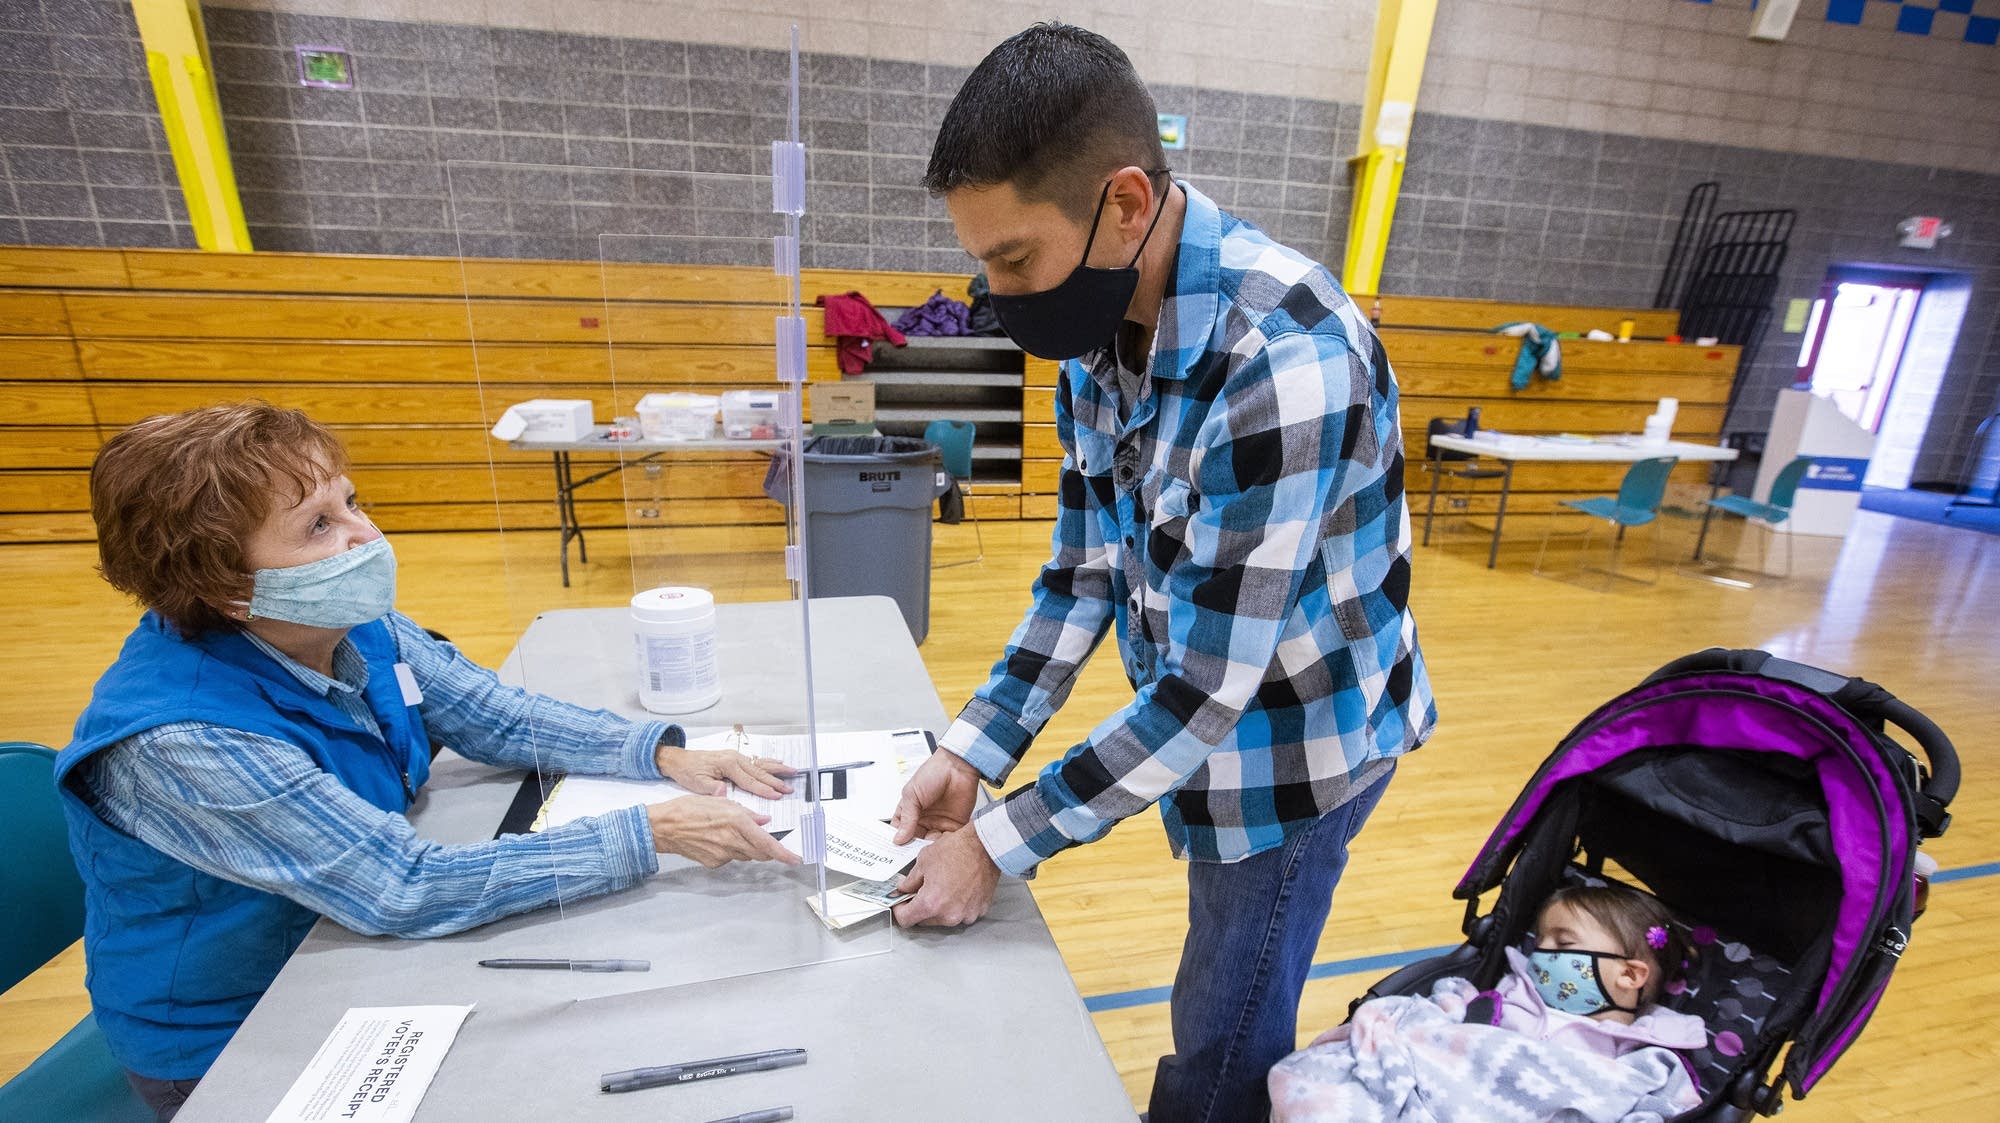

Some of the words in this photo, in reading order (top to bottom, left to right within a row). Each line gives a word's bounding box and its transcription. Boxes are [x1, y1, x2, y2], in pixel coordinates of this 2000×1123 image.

[859, 471, 901, 481] BRUTE
[825, 833, 853, 852] RECE
[826, 843, 875, 867] REGISTER
[853, 847, 894, 865] VOTER'S
[376, 1019, 413, 1065] VOTER'S
[371, 1031, 423, 1103] REGISTERED
[341, 1068, 383, 1119] RECEIPT
